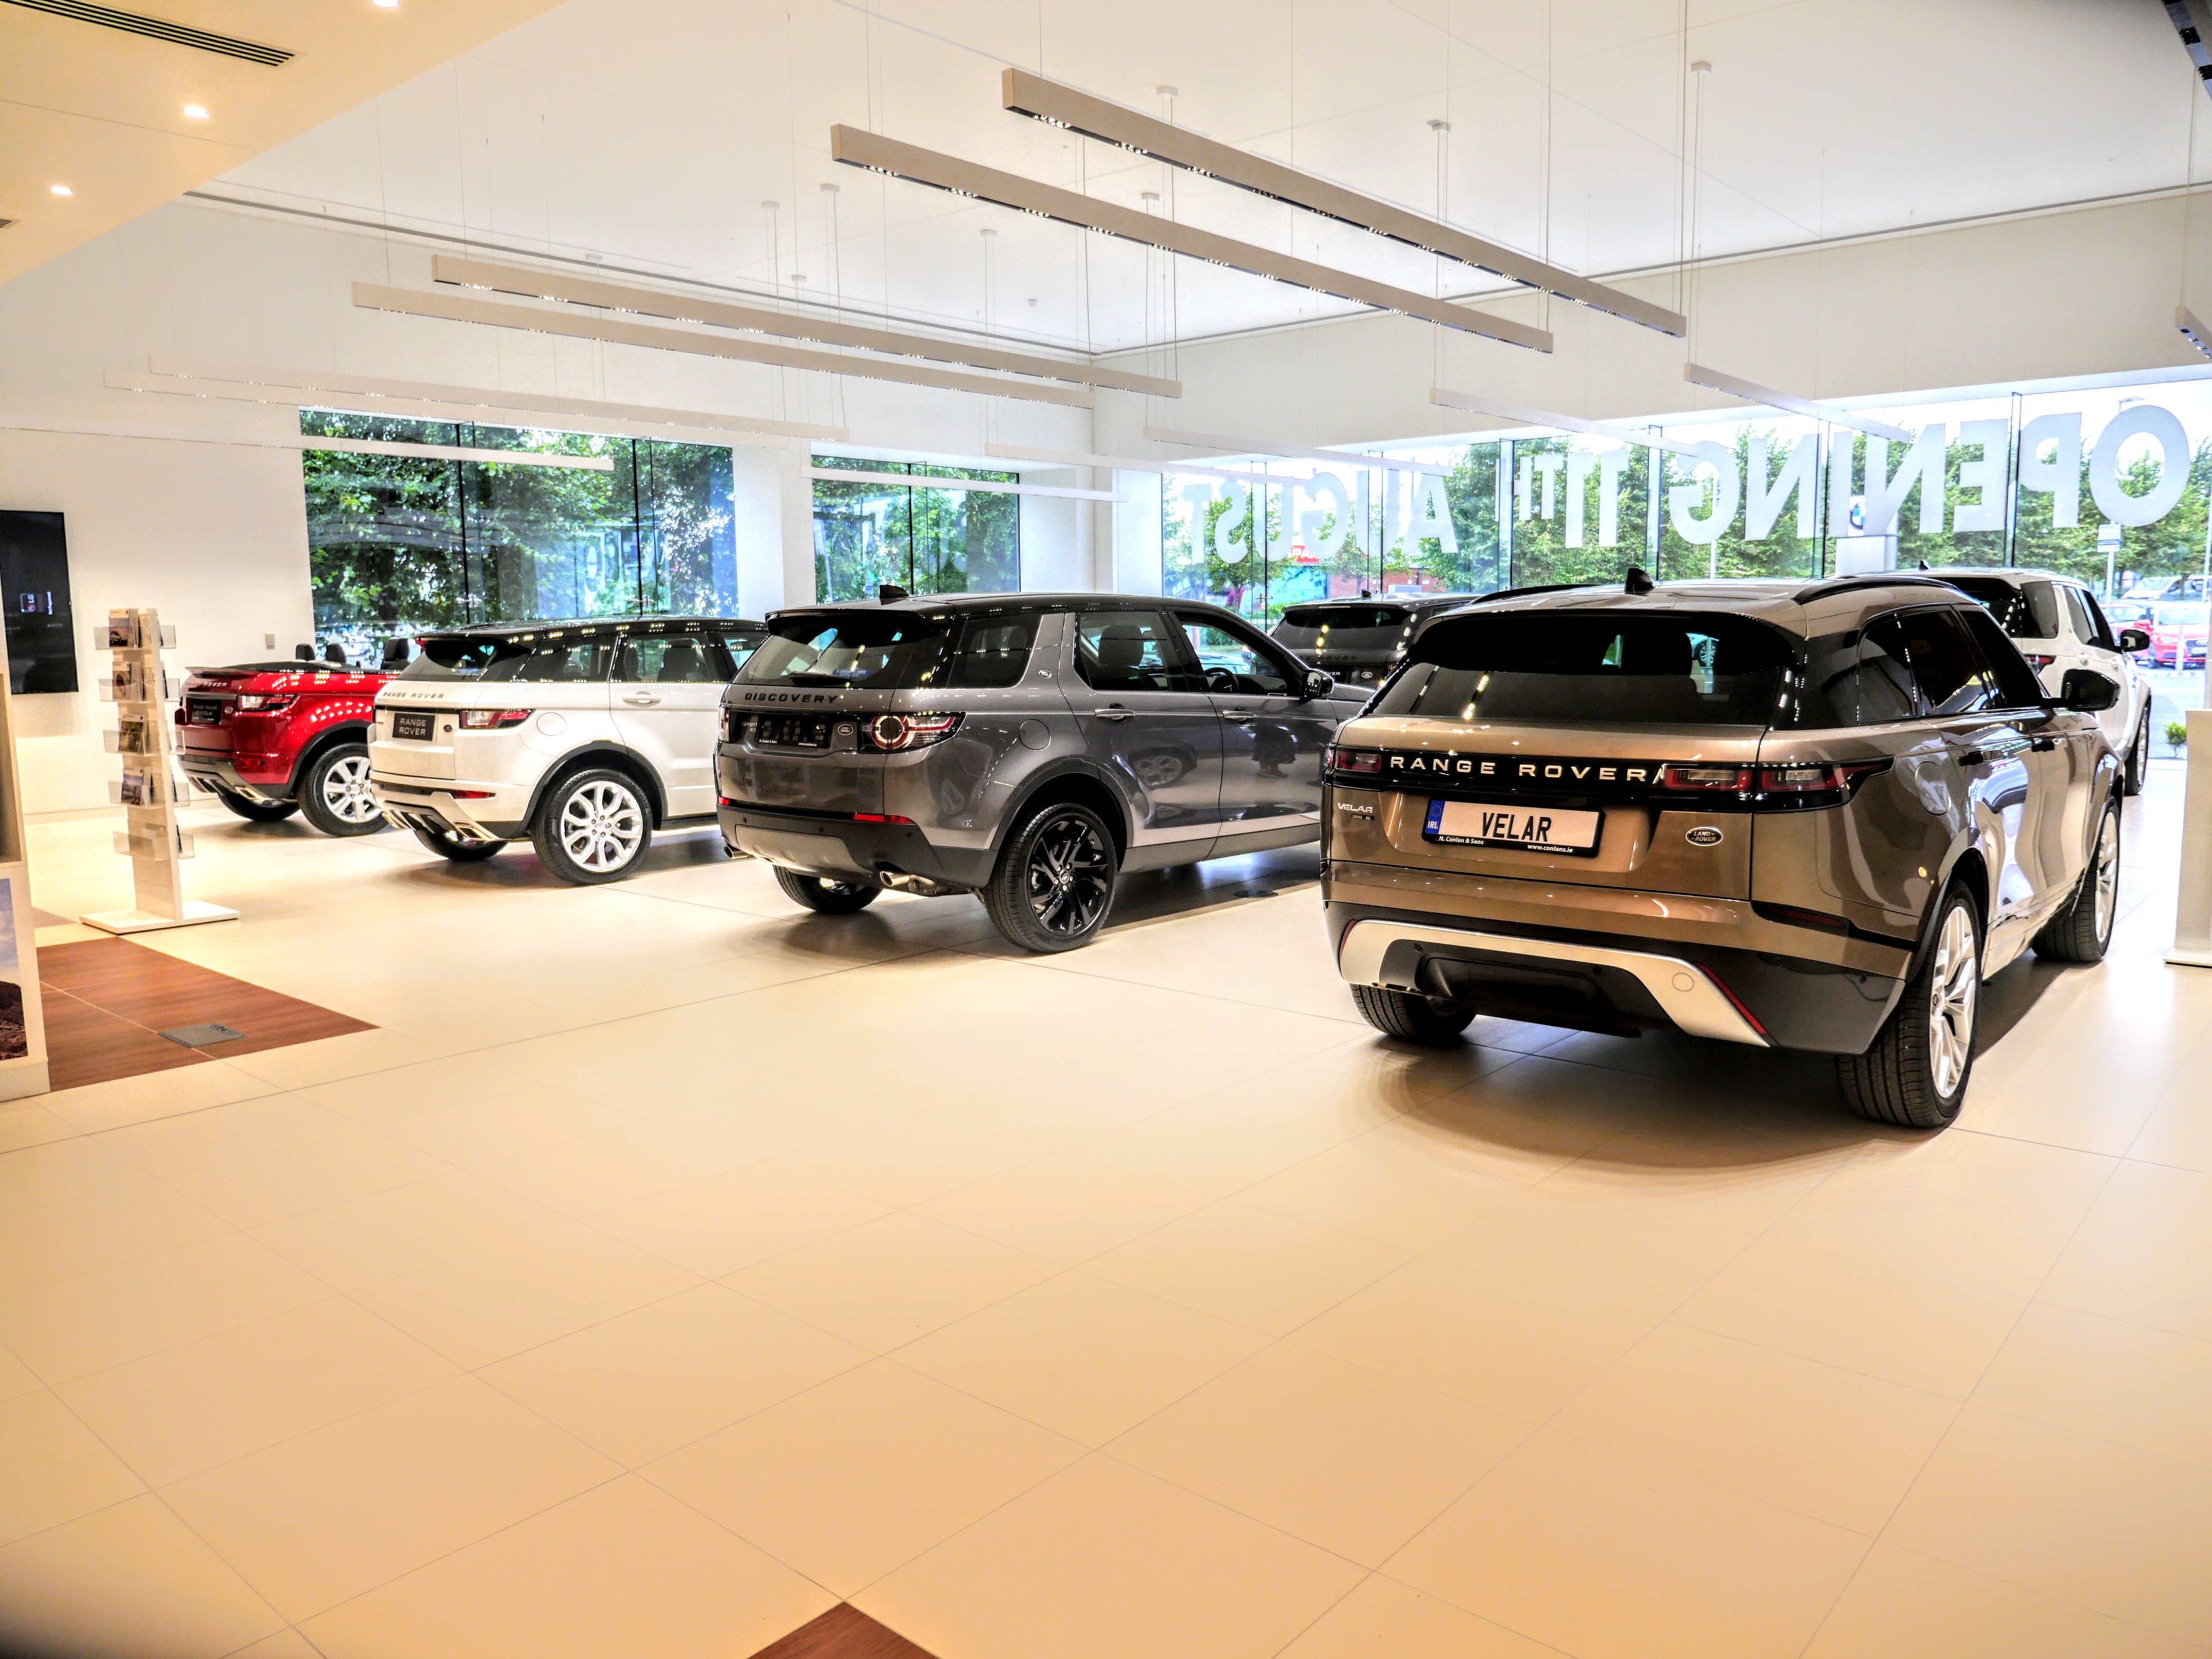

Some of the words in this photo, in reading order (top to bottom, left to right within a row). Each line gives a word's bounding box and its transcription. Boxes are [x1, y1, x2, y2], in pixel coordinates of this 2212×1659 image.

[1286, 549, 1313, 559] SPA
[745, 693, 838, 703] DISCOVERY
[400, 718, 426, 727] RANGE
[399, 727, 426, 736] ROVER
[1390, 757, 1495, 775] RANGE
[1519, 764, 1646, 782] ROVER
[1337, 803, 1373, 813] VELAR
[1427, 821, 1438, 829] IRL
[1482, 812, 1551, 842] VELAR
[1527, 844, 1573, 853] www.conlans.ie
